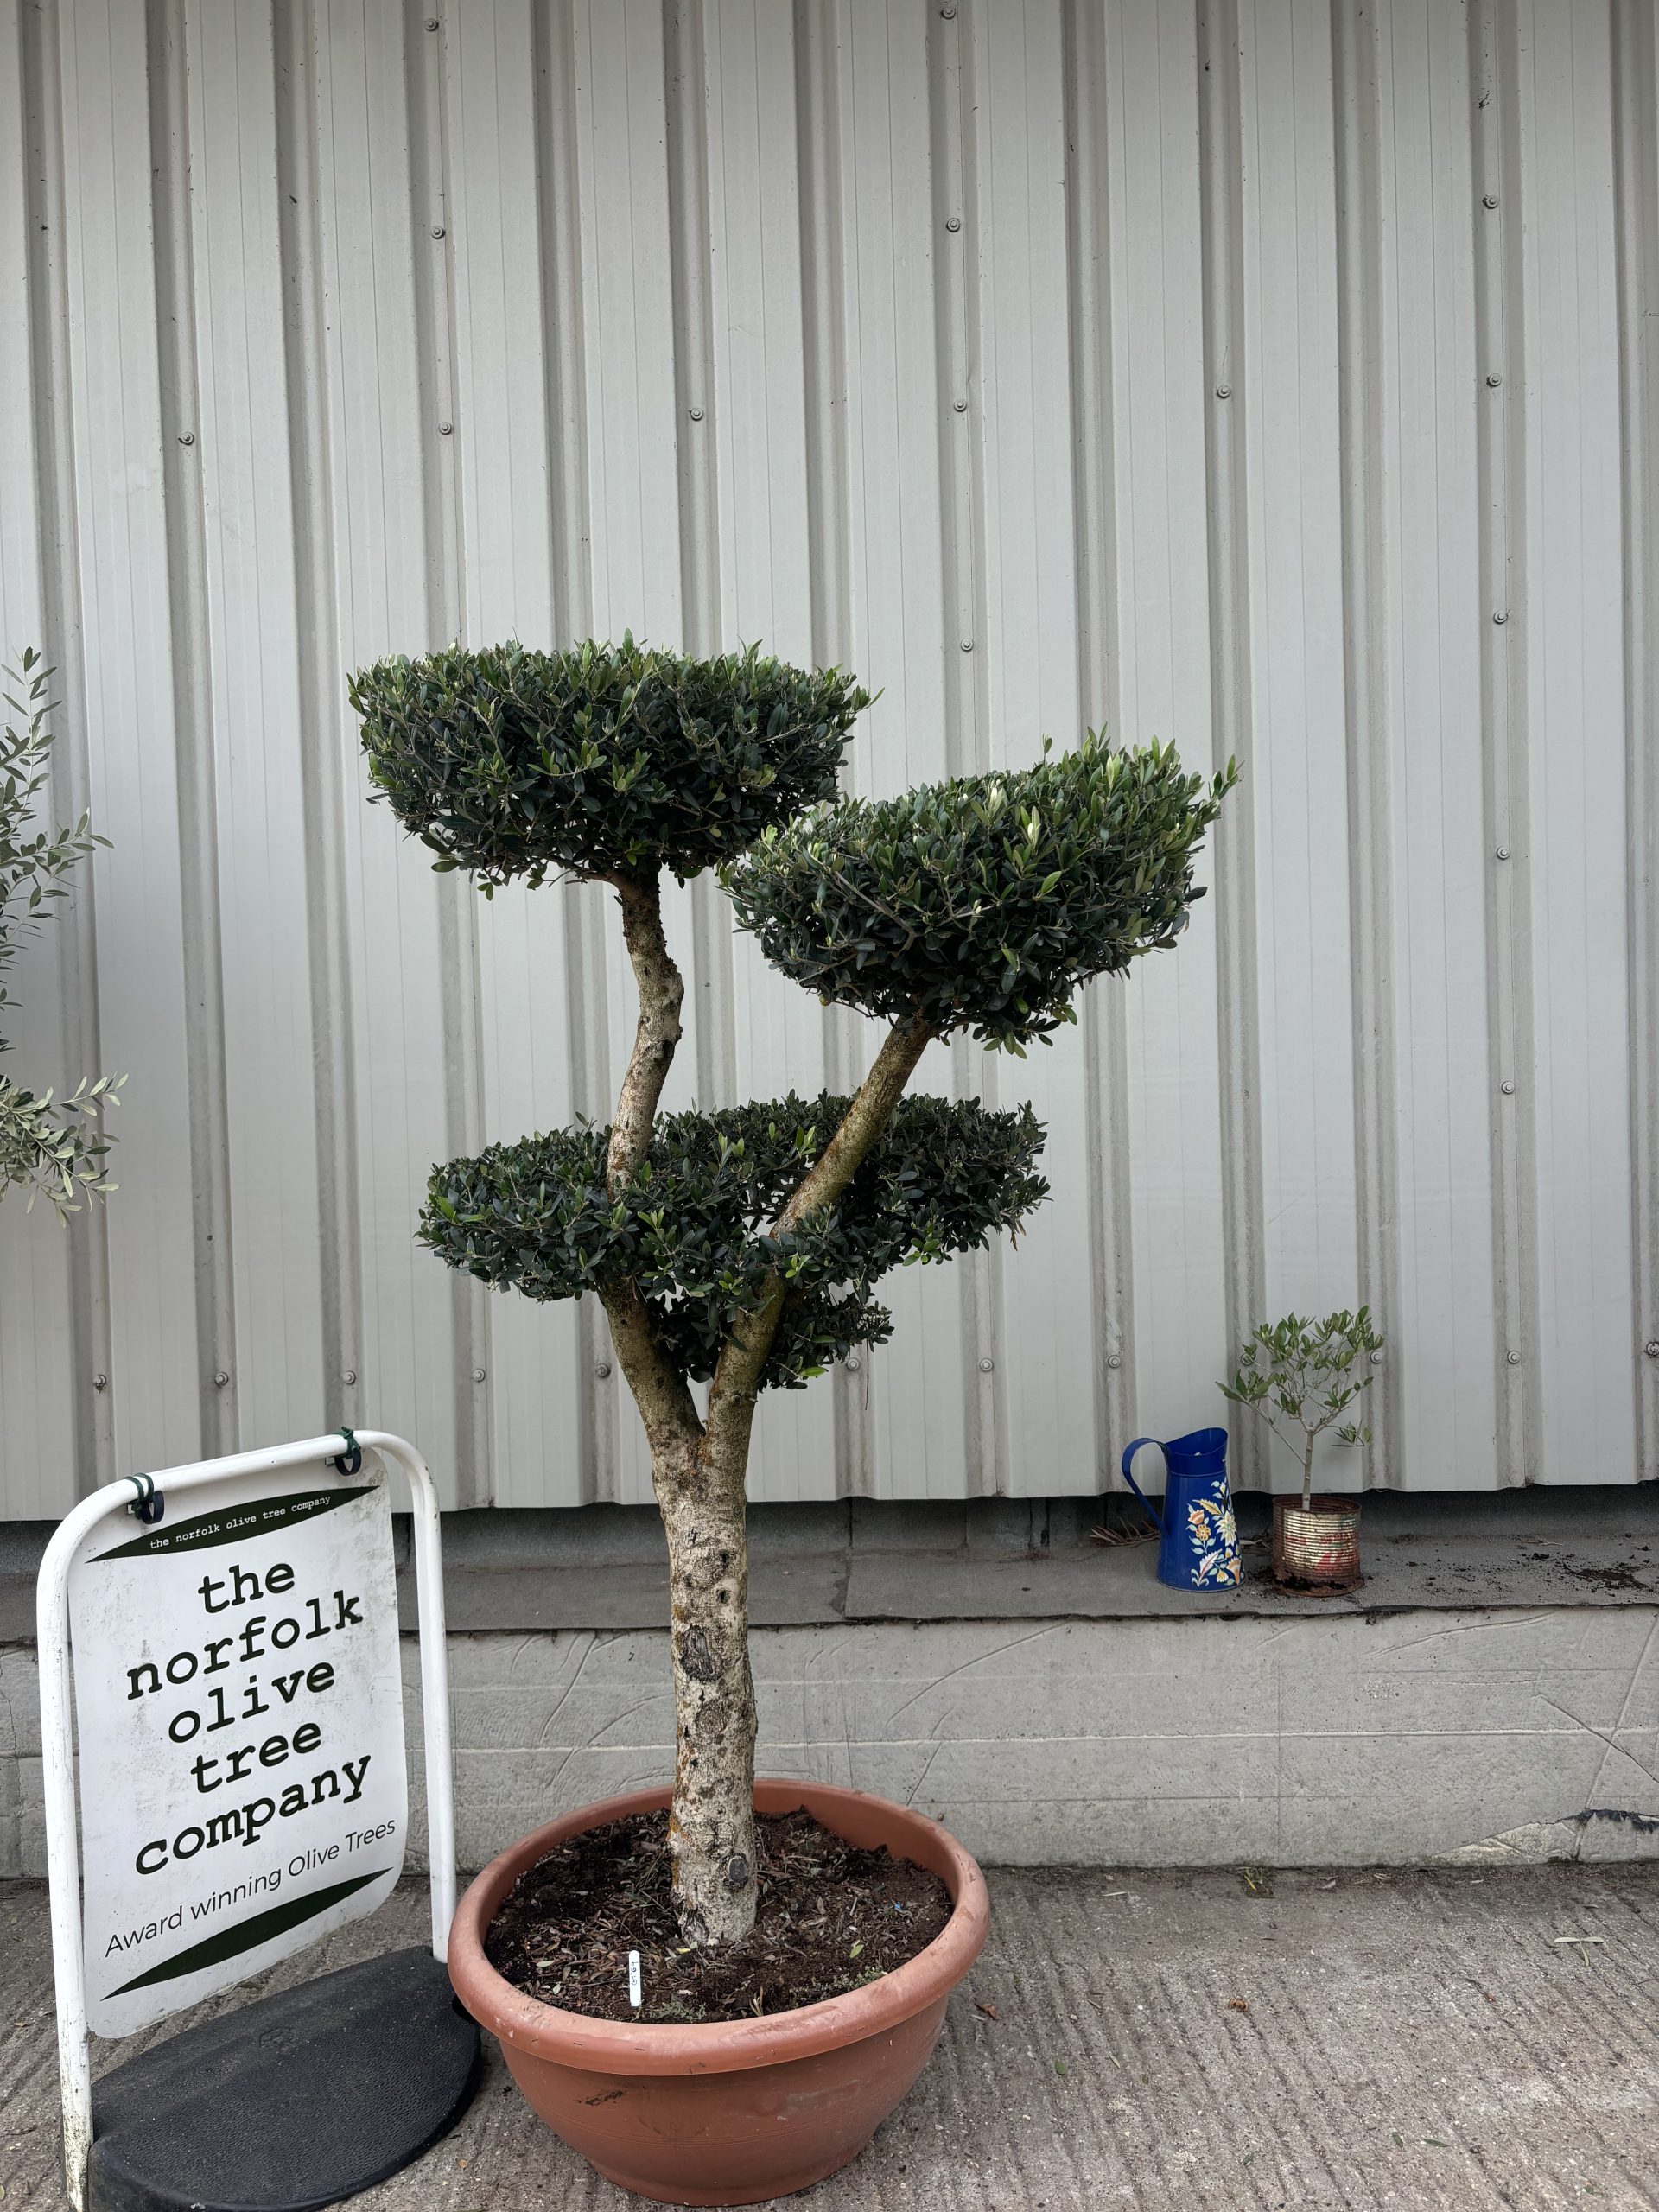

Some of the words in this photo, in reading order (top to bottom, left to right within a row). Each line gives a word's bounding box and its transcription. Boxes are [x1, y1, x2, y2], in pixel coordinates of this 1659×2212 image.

[149, 1537, 169, 1549] the
[175, 1523, 220, 1543] norfolk
[226, 1515, 257, 1530] olive
[262, 1507, 286, 1520] tree
[290, 1495, 331, 1512] company
[197, 1563, 295, 1614] the
[126, 1589, 364, 1700] norfolk
[168, 1662, 335, 1744] olive
[190, 1722, 321, 1794] tree
[135, 1755, 372, 1875] company
[105, 1904, 183, 1958] Award
[190, 1868, 282, 1920] winning
[288, 1843, 340, 1877] Olive
[345, 1820, 396, 1853] Trees
